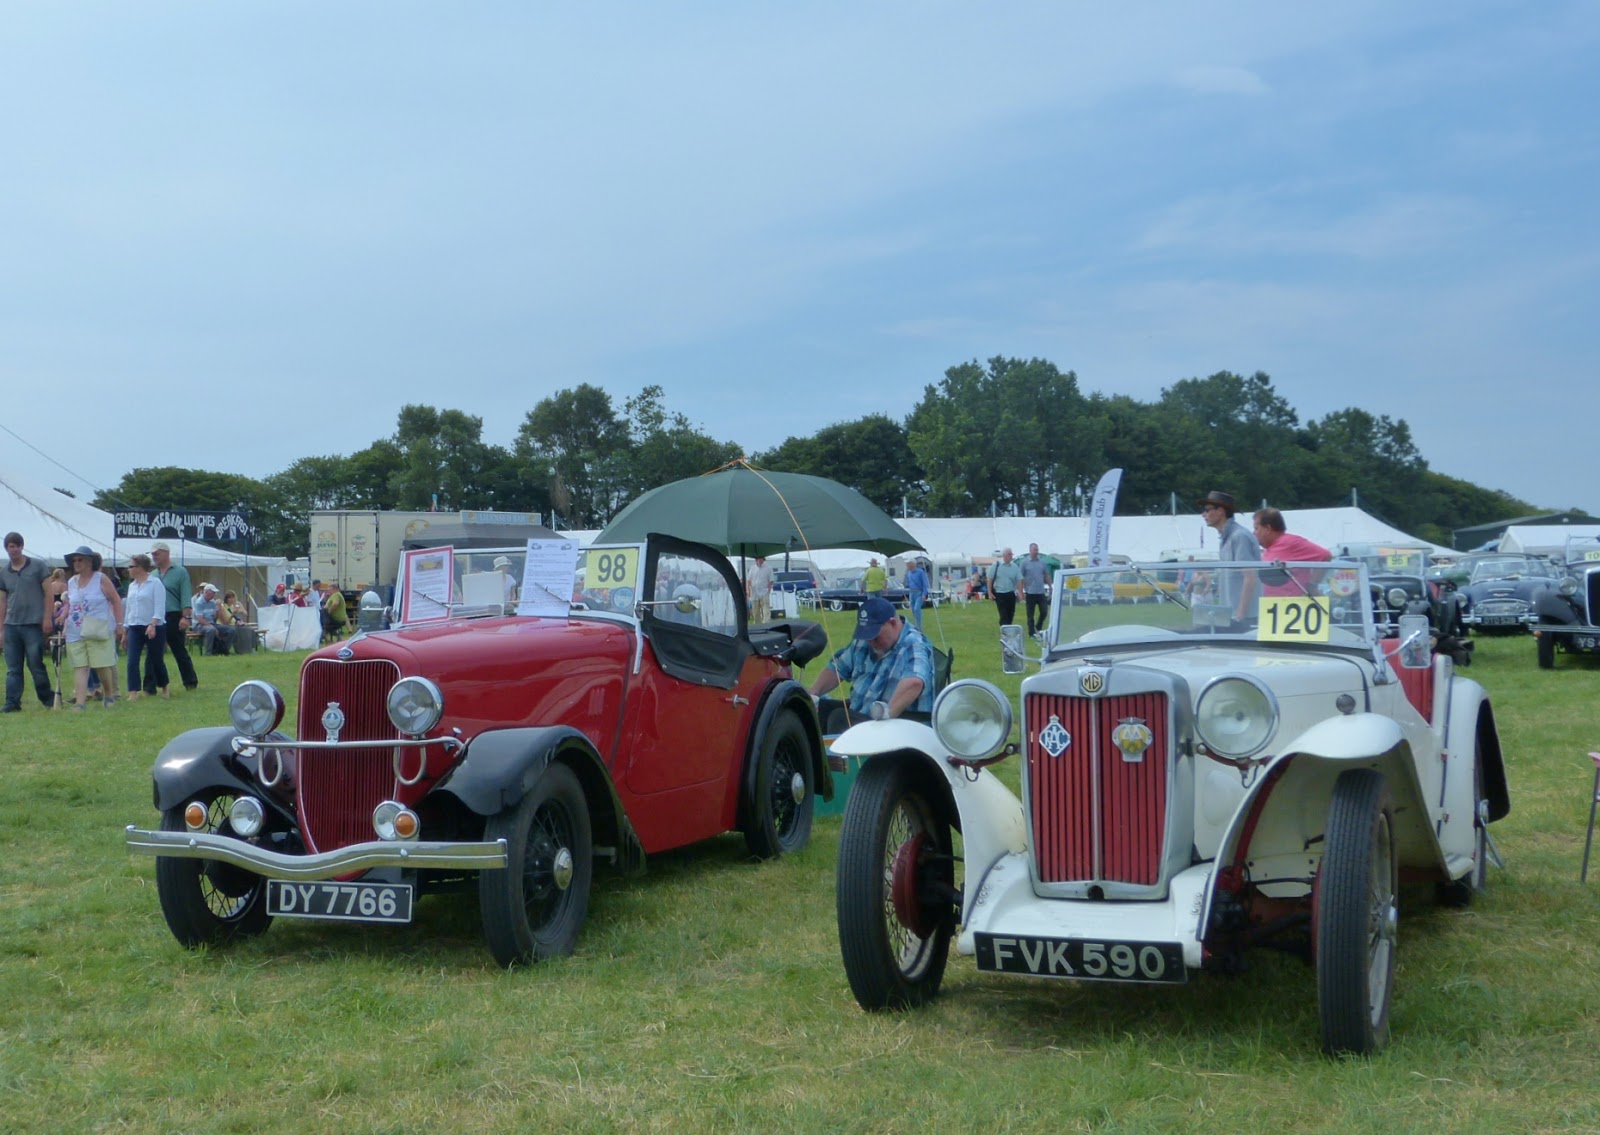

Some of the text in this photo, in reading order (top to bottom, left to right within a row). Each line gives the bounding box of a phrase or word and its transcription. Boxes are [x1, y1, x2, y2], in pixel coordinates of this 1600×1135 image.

[115, 512, 149, 525] GENERAL
[117, 524, 148, 536] PUBLIC
[148, 511, 185, 538] CATERING
[183, 514, 215, 528] LUNCHES
[1092, 498, 1107, 554] Owners Club
[597, 553, 627, 583] 98
[1267, 603, 1322, 635] 120
[1083, 672, 1101, 692] MG
[1044, 726, 1067, 750] RAC
[1122, 725, 1143, 740] AA
[280, 884, 397, 917] DY 7766
[993, 938, 1165, 979] FVK 590
